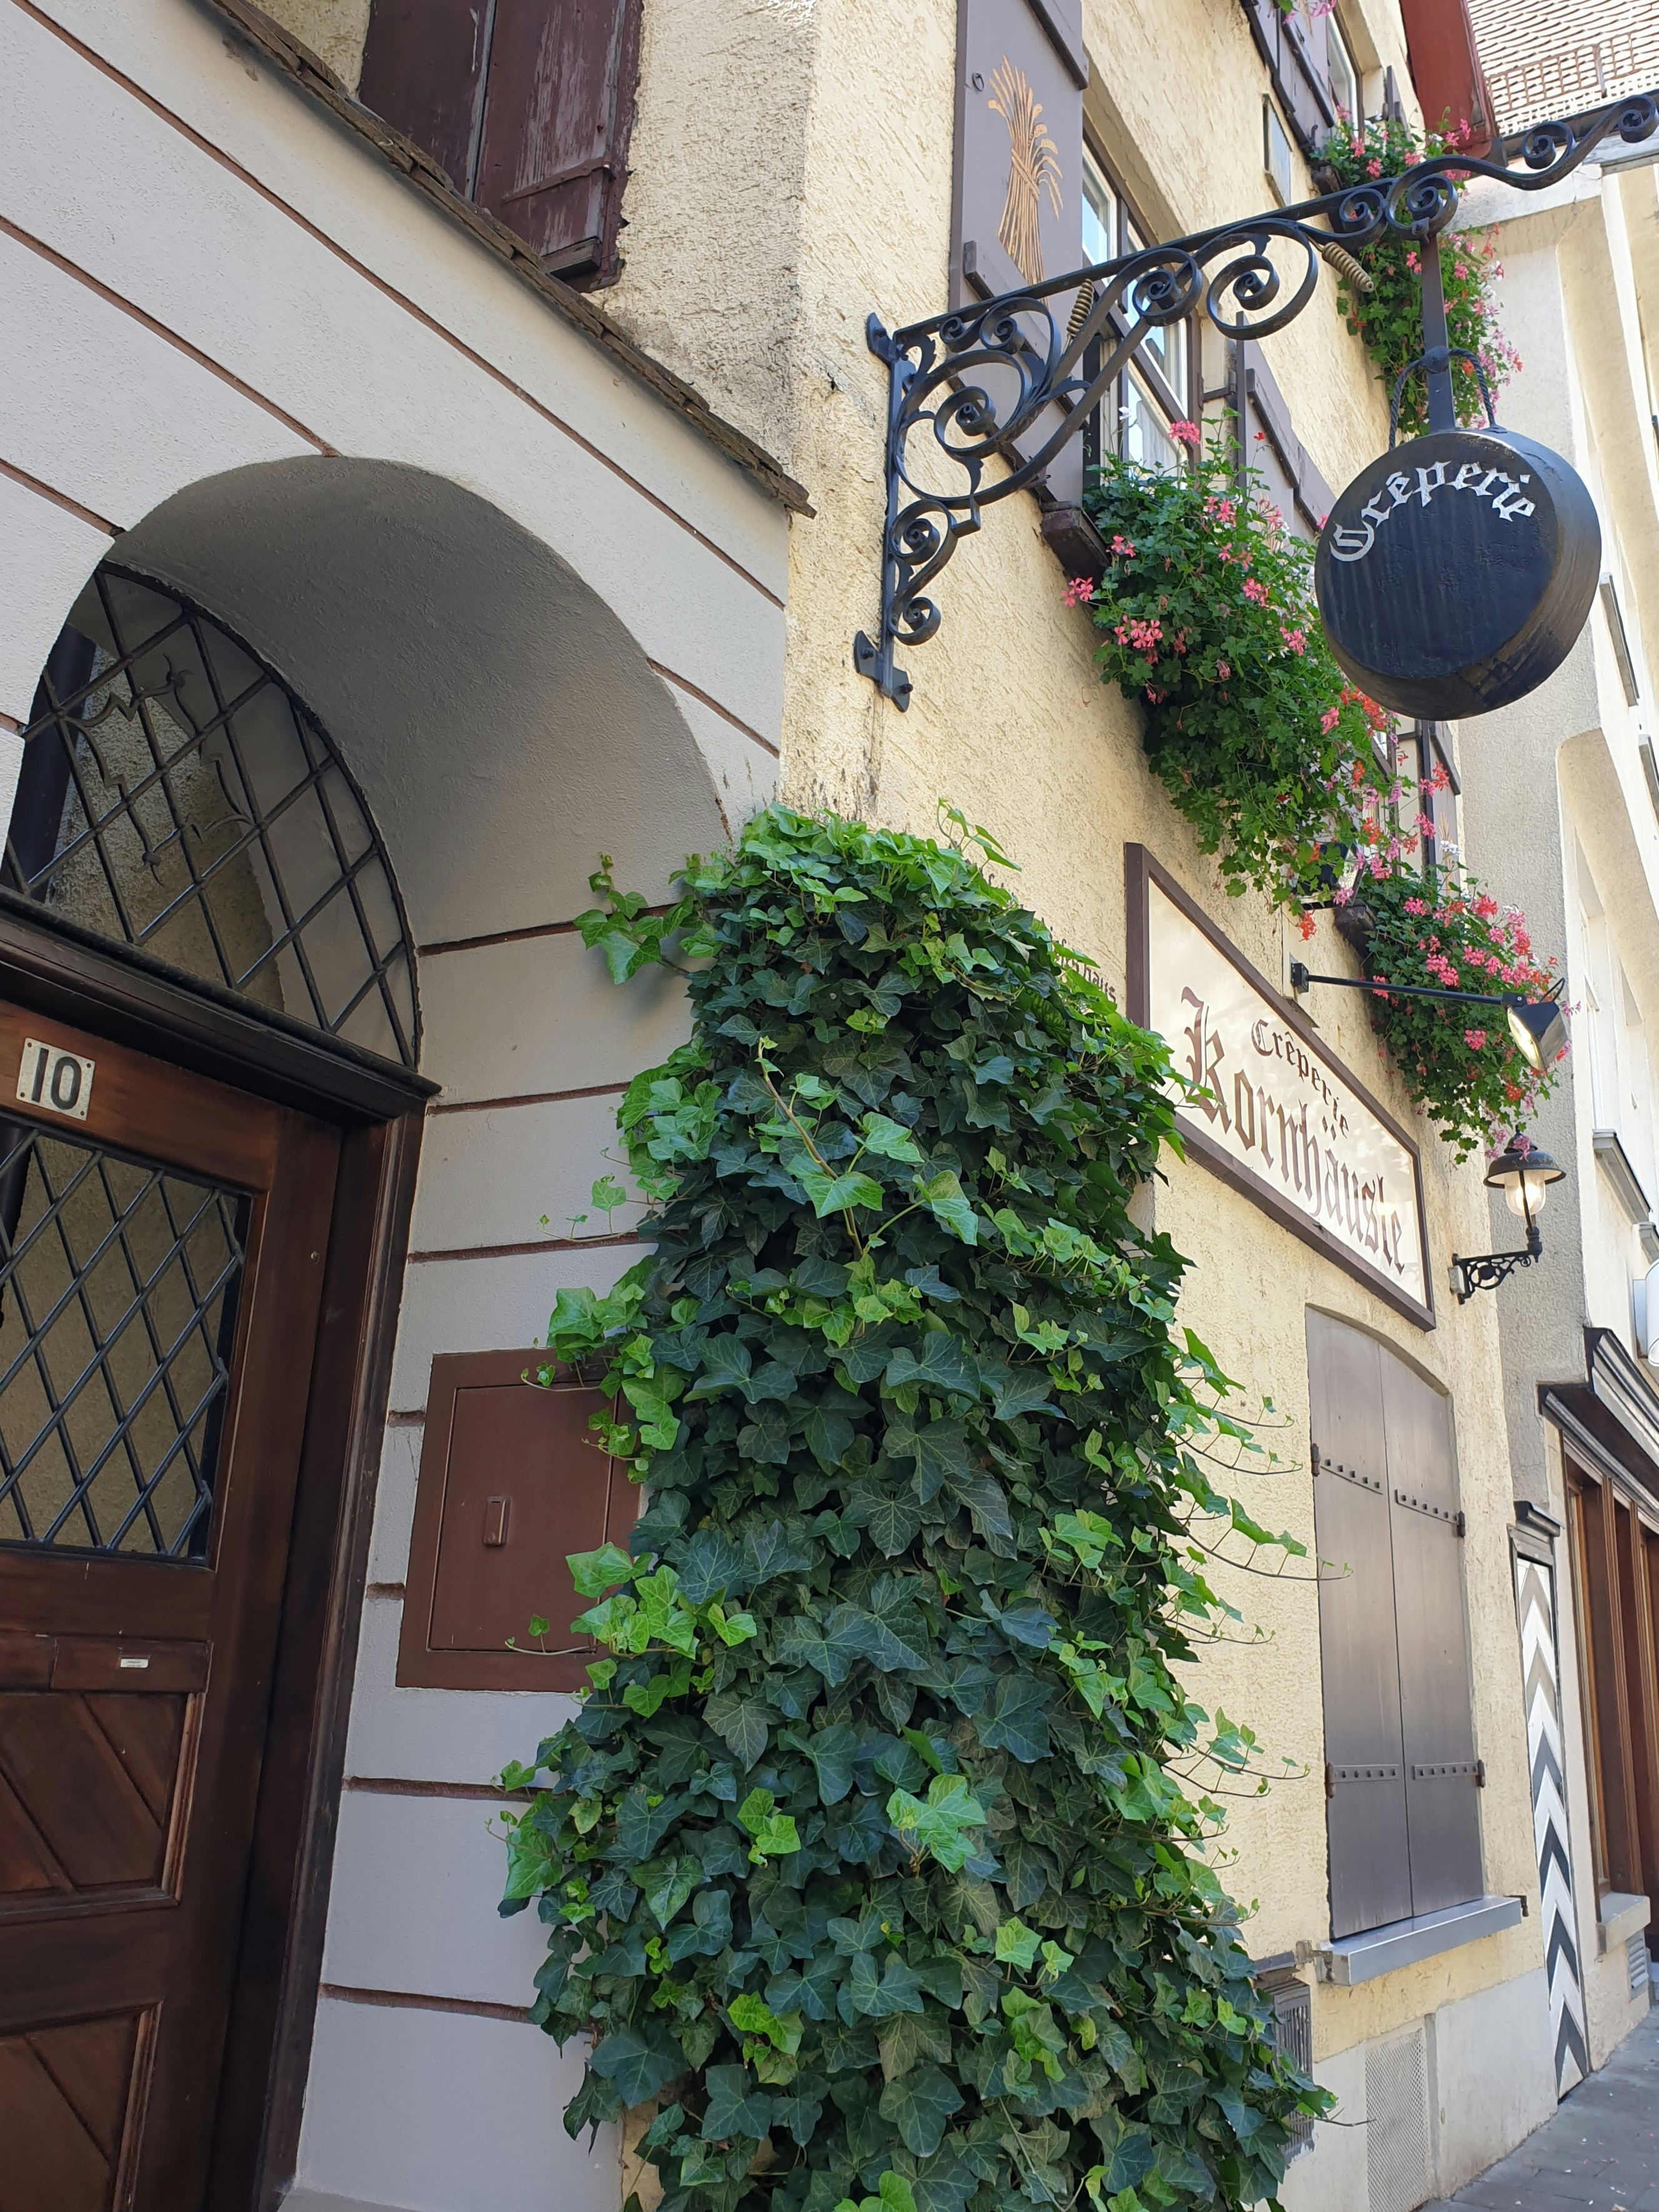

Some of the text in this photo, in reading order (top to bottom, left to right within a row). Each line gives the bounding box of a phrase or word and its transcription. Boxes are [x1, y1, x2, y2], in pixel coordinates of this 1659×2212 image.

[1329, 460, 1536, 562] Crêperie
[31, 1047, 82, 1110] 10
[1181, 986, 1405, 1276] Kornhäusle
[1251, 1019, 1350, 1139] Crêperie
